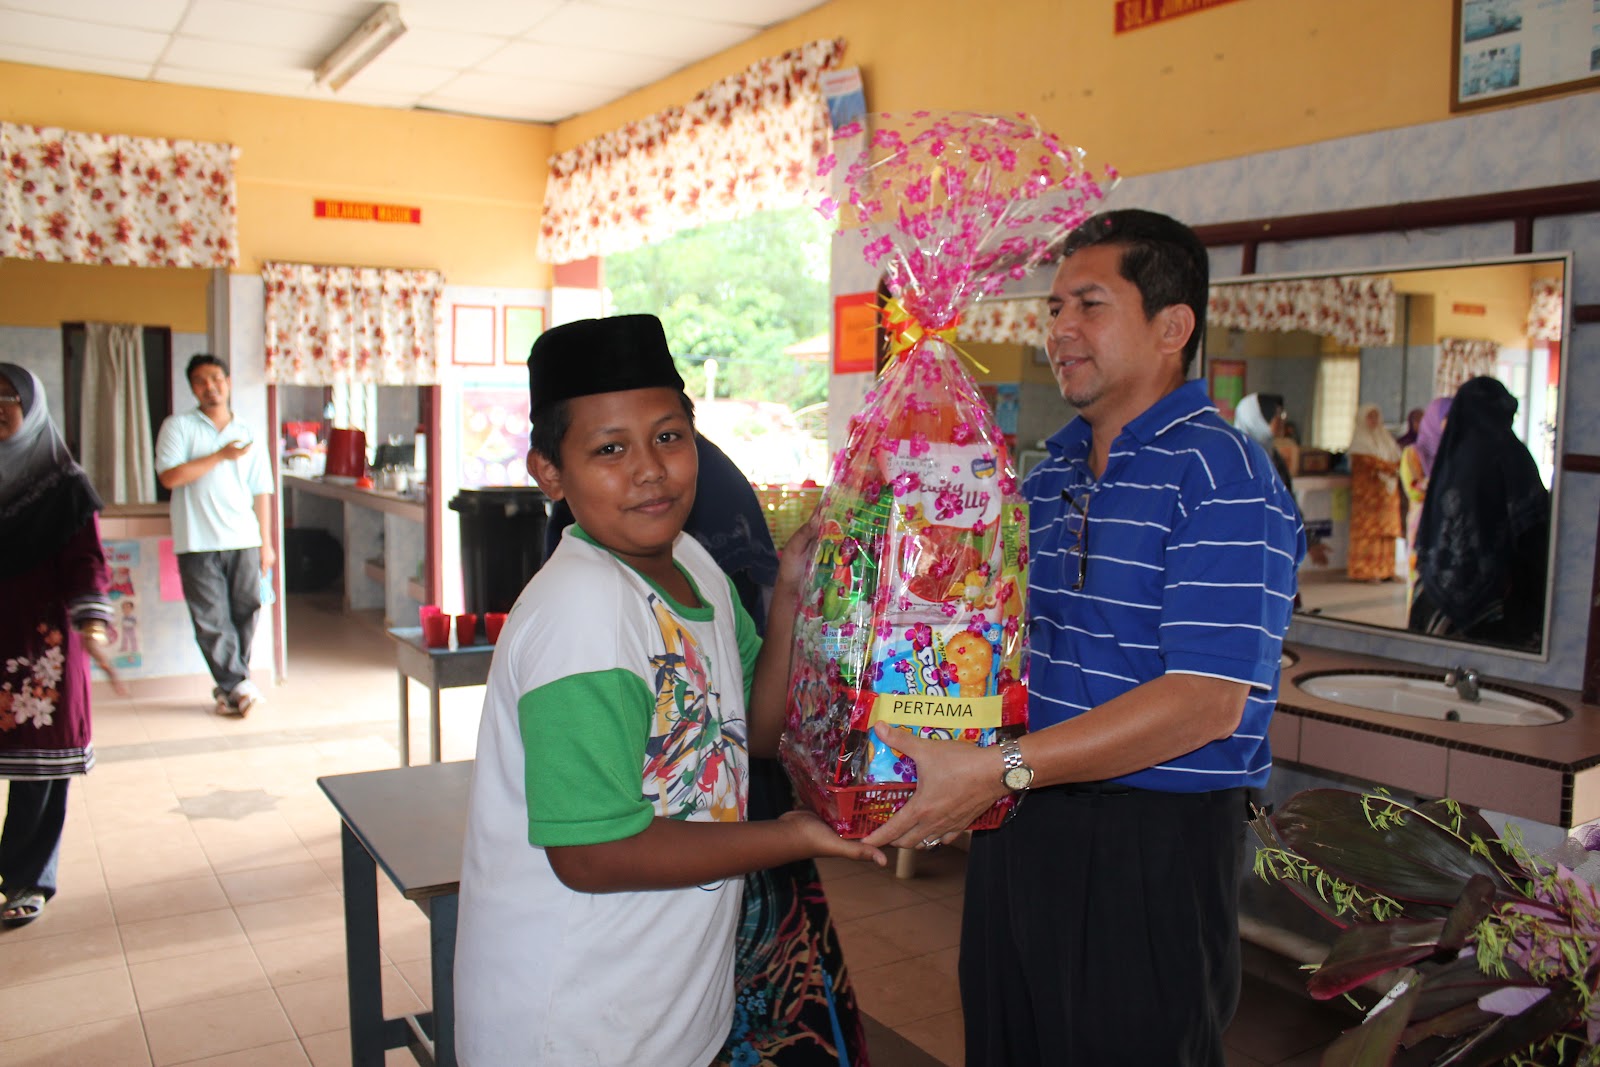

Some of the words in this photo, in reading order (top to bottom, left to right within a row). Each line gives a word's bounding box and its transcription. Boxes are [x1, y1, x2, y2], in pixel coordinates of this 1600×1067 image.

[906, 480, 964, 498] ruity
[935, 491, 990, 521] elly
[893, 700, 973, 718] PERTAMA
